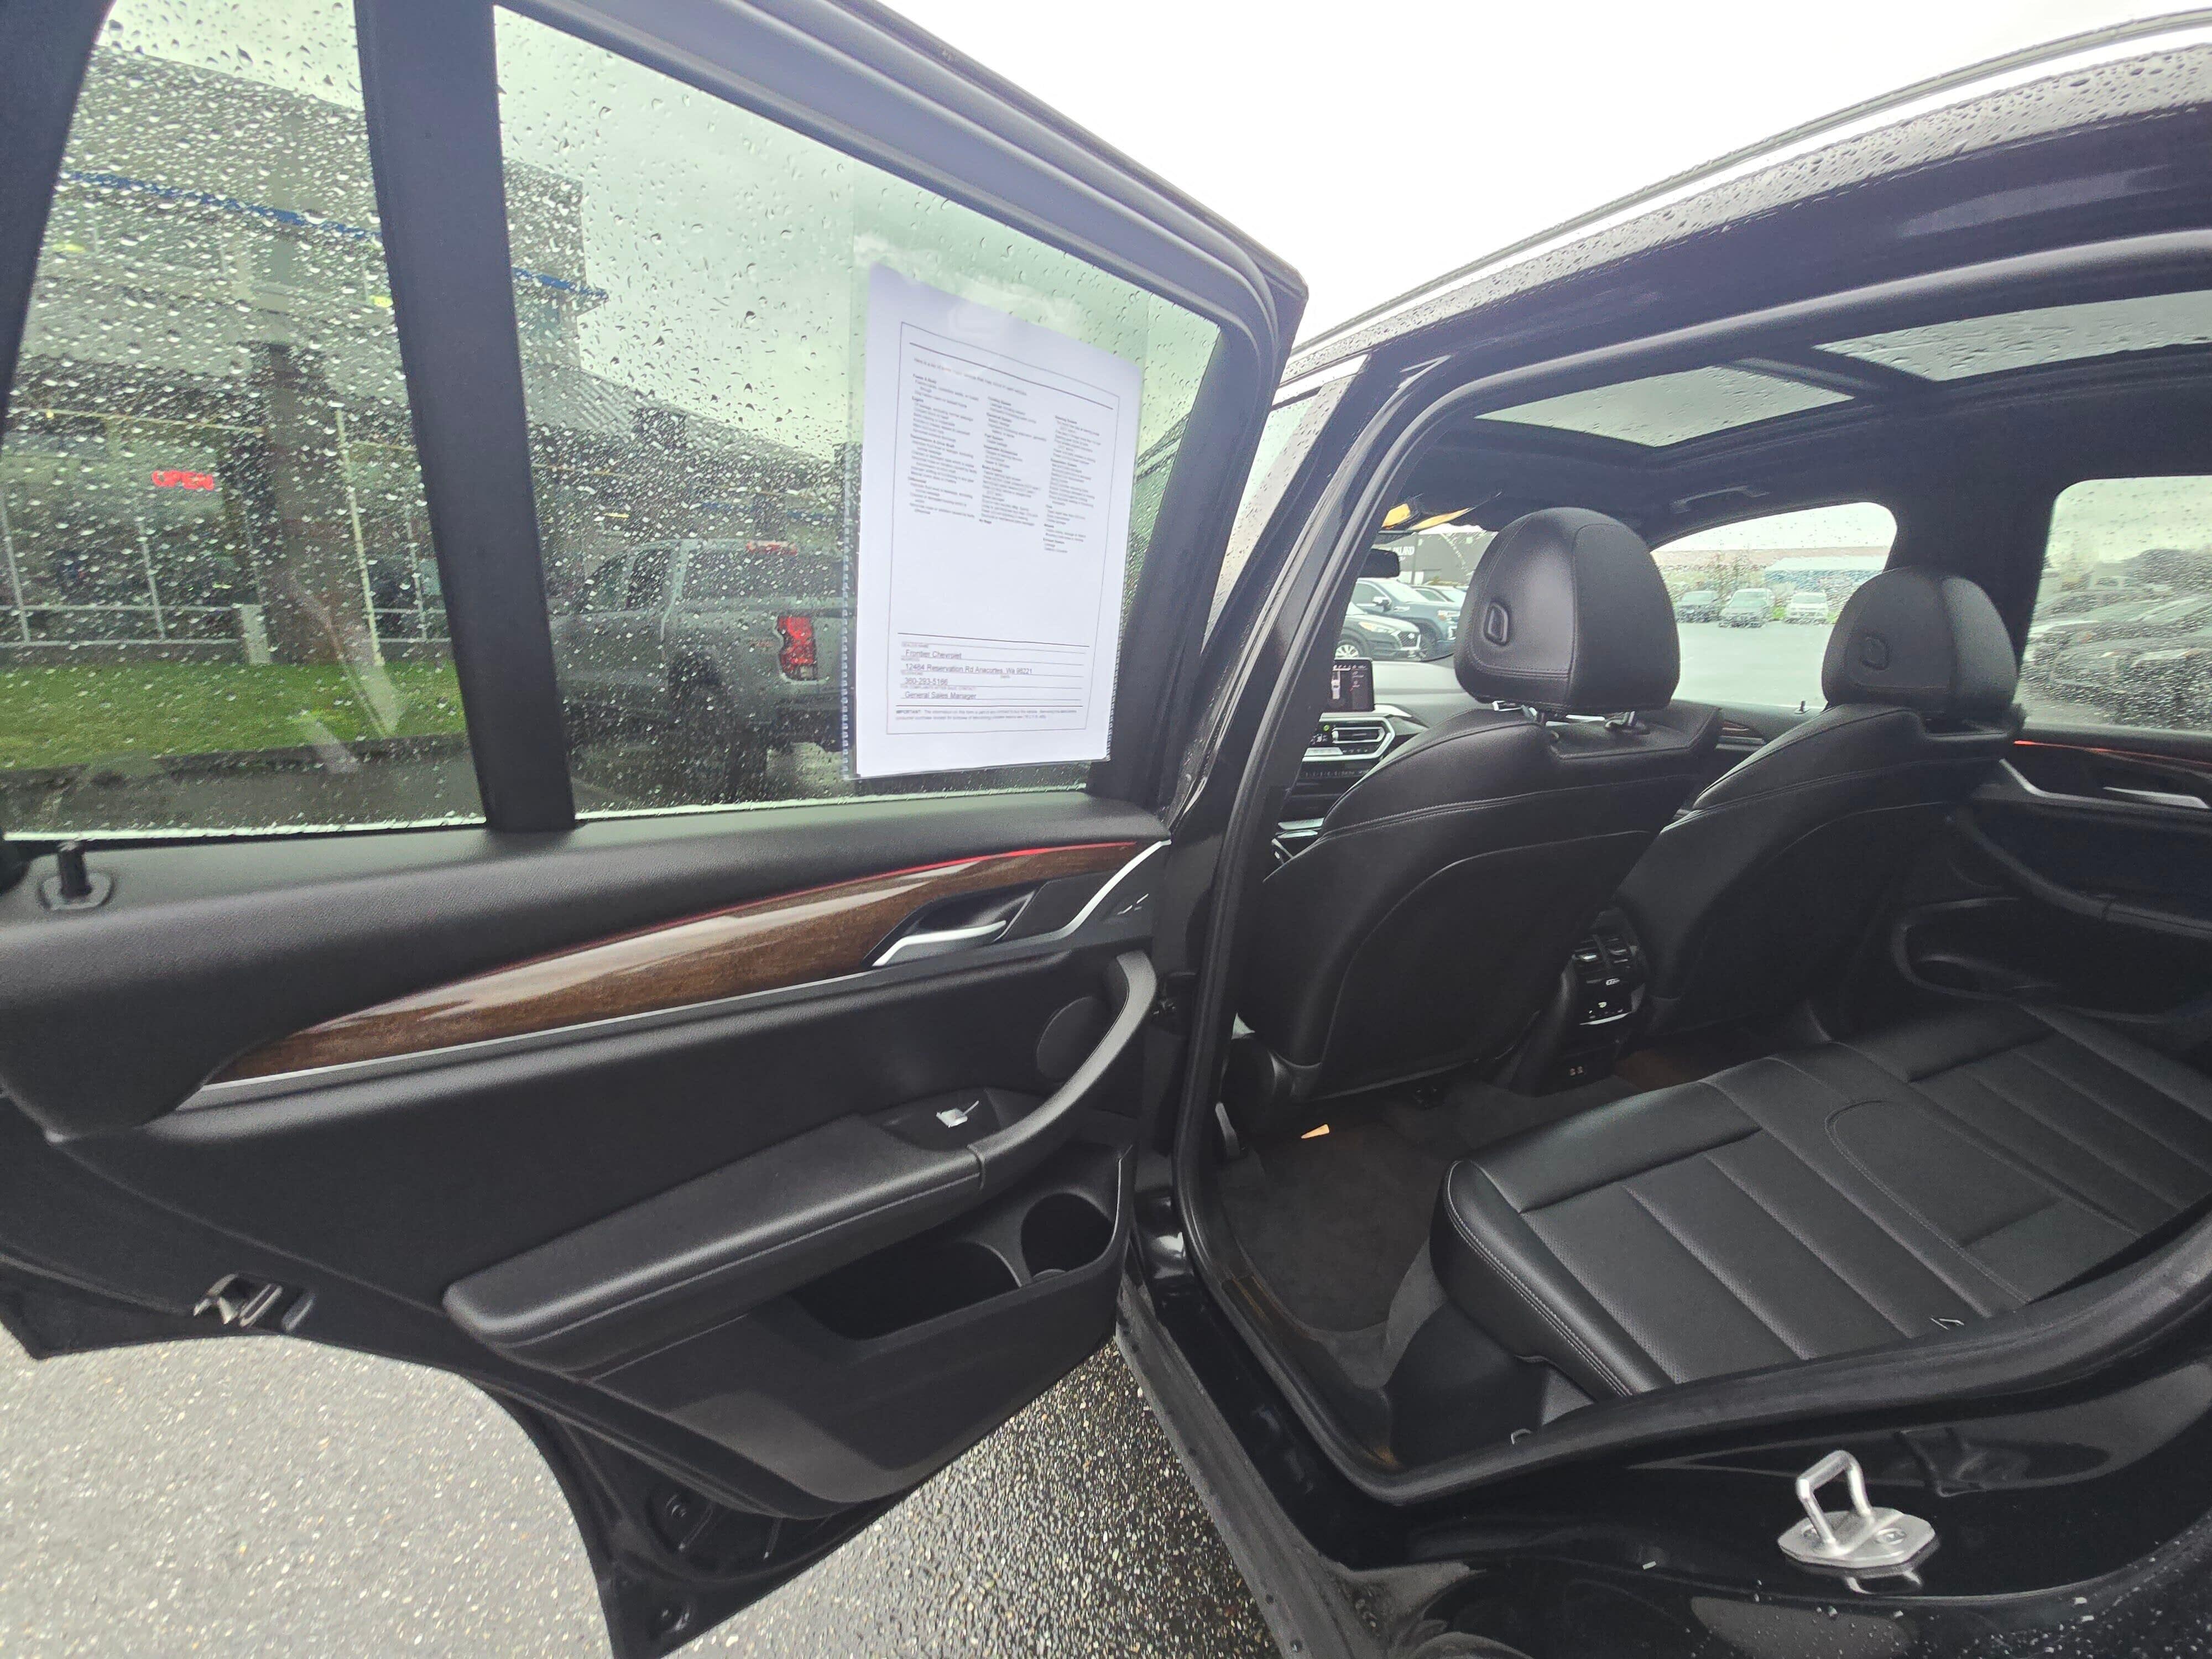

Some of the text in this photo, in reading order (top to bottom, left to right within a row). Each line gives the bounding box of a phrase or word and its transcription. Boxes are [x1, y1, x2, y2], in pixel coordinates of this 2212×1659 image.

[905, 649, 930, 658] Frontier
[926, 664, 963, 672] Reservation
[951, 692, 977, 701] Manager
